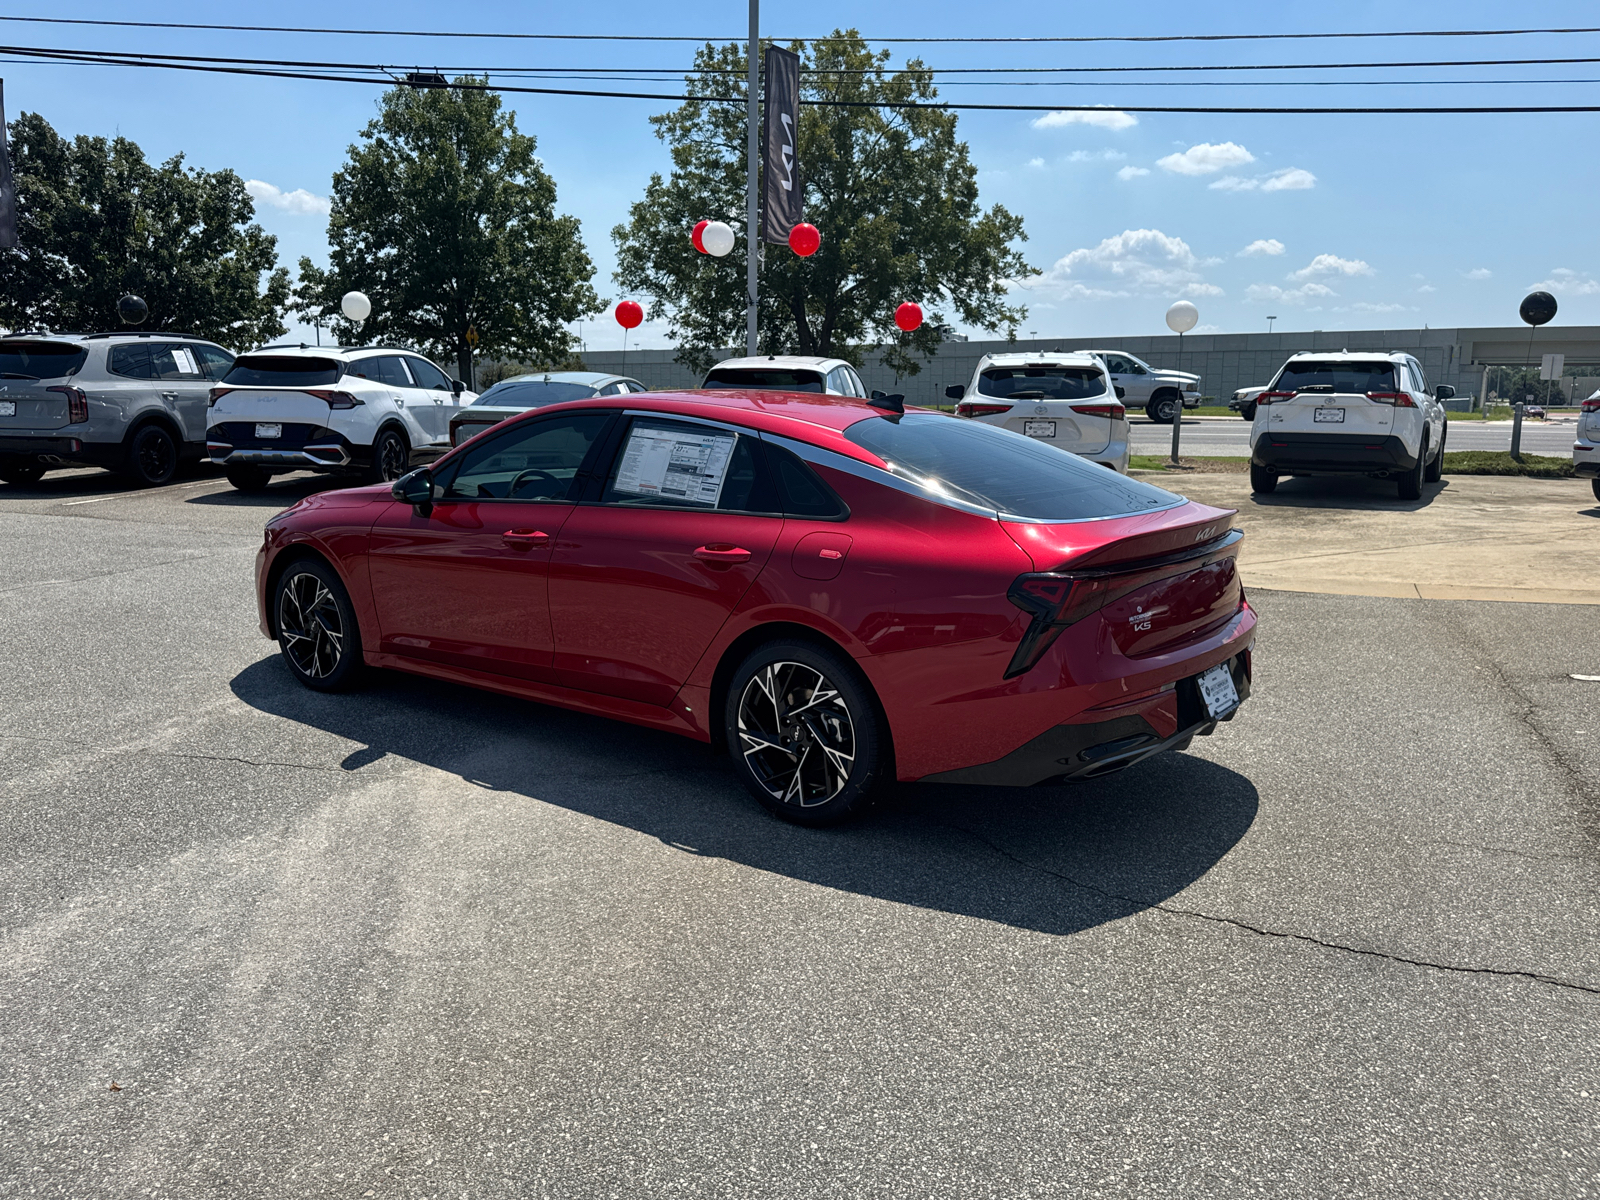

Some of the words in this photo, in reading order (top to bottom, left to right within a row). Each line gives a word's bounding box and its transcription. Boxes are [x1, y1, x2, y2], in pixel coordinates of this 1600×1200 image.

[781, 112, 793, 192] KIA
[1195, 526, 1217, 541] KIA
[1134, 621, 1151, 632] K5
